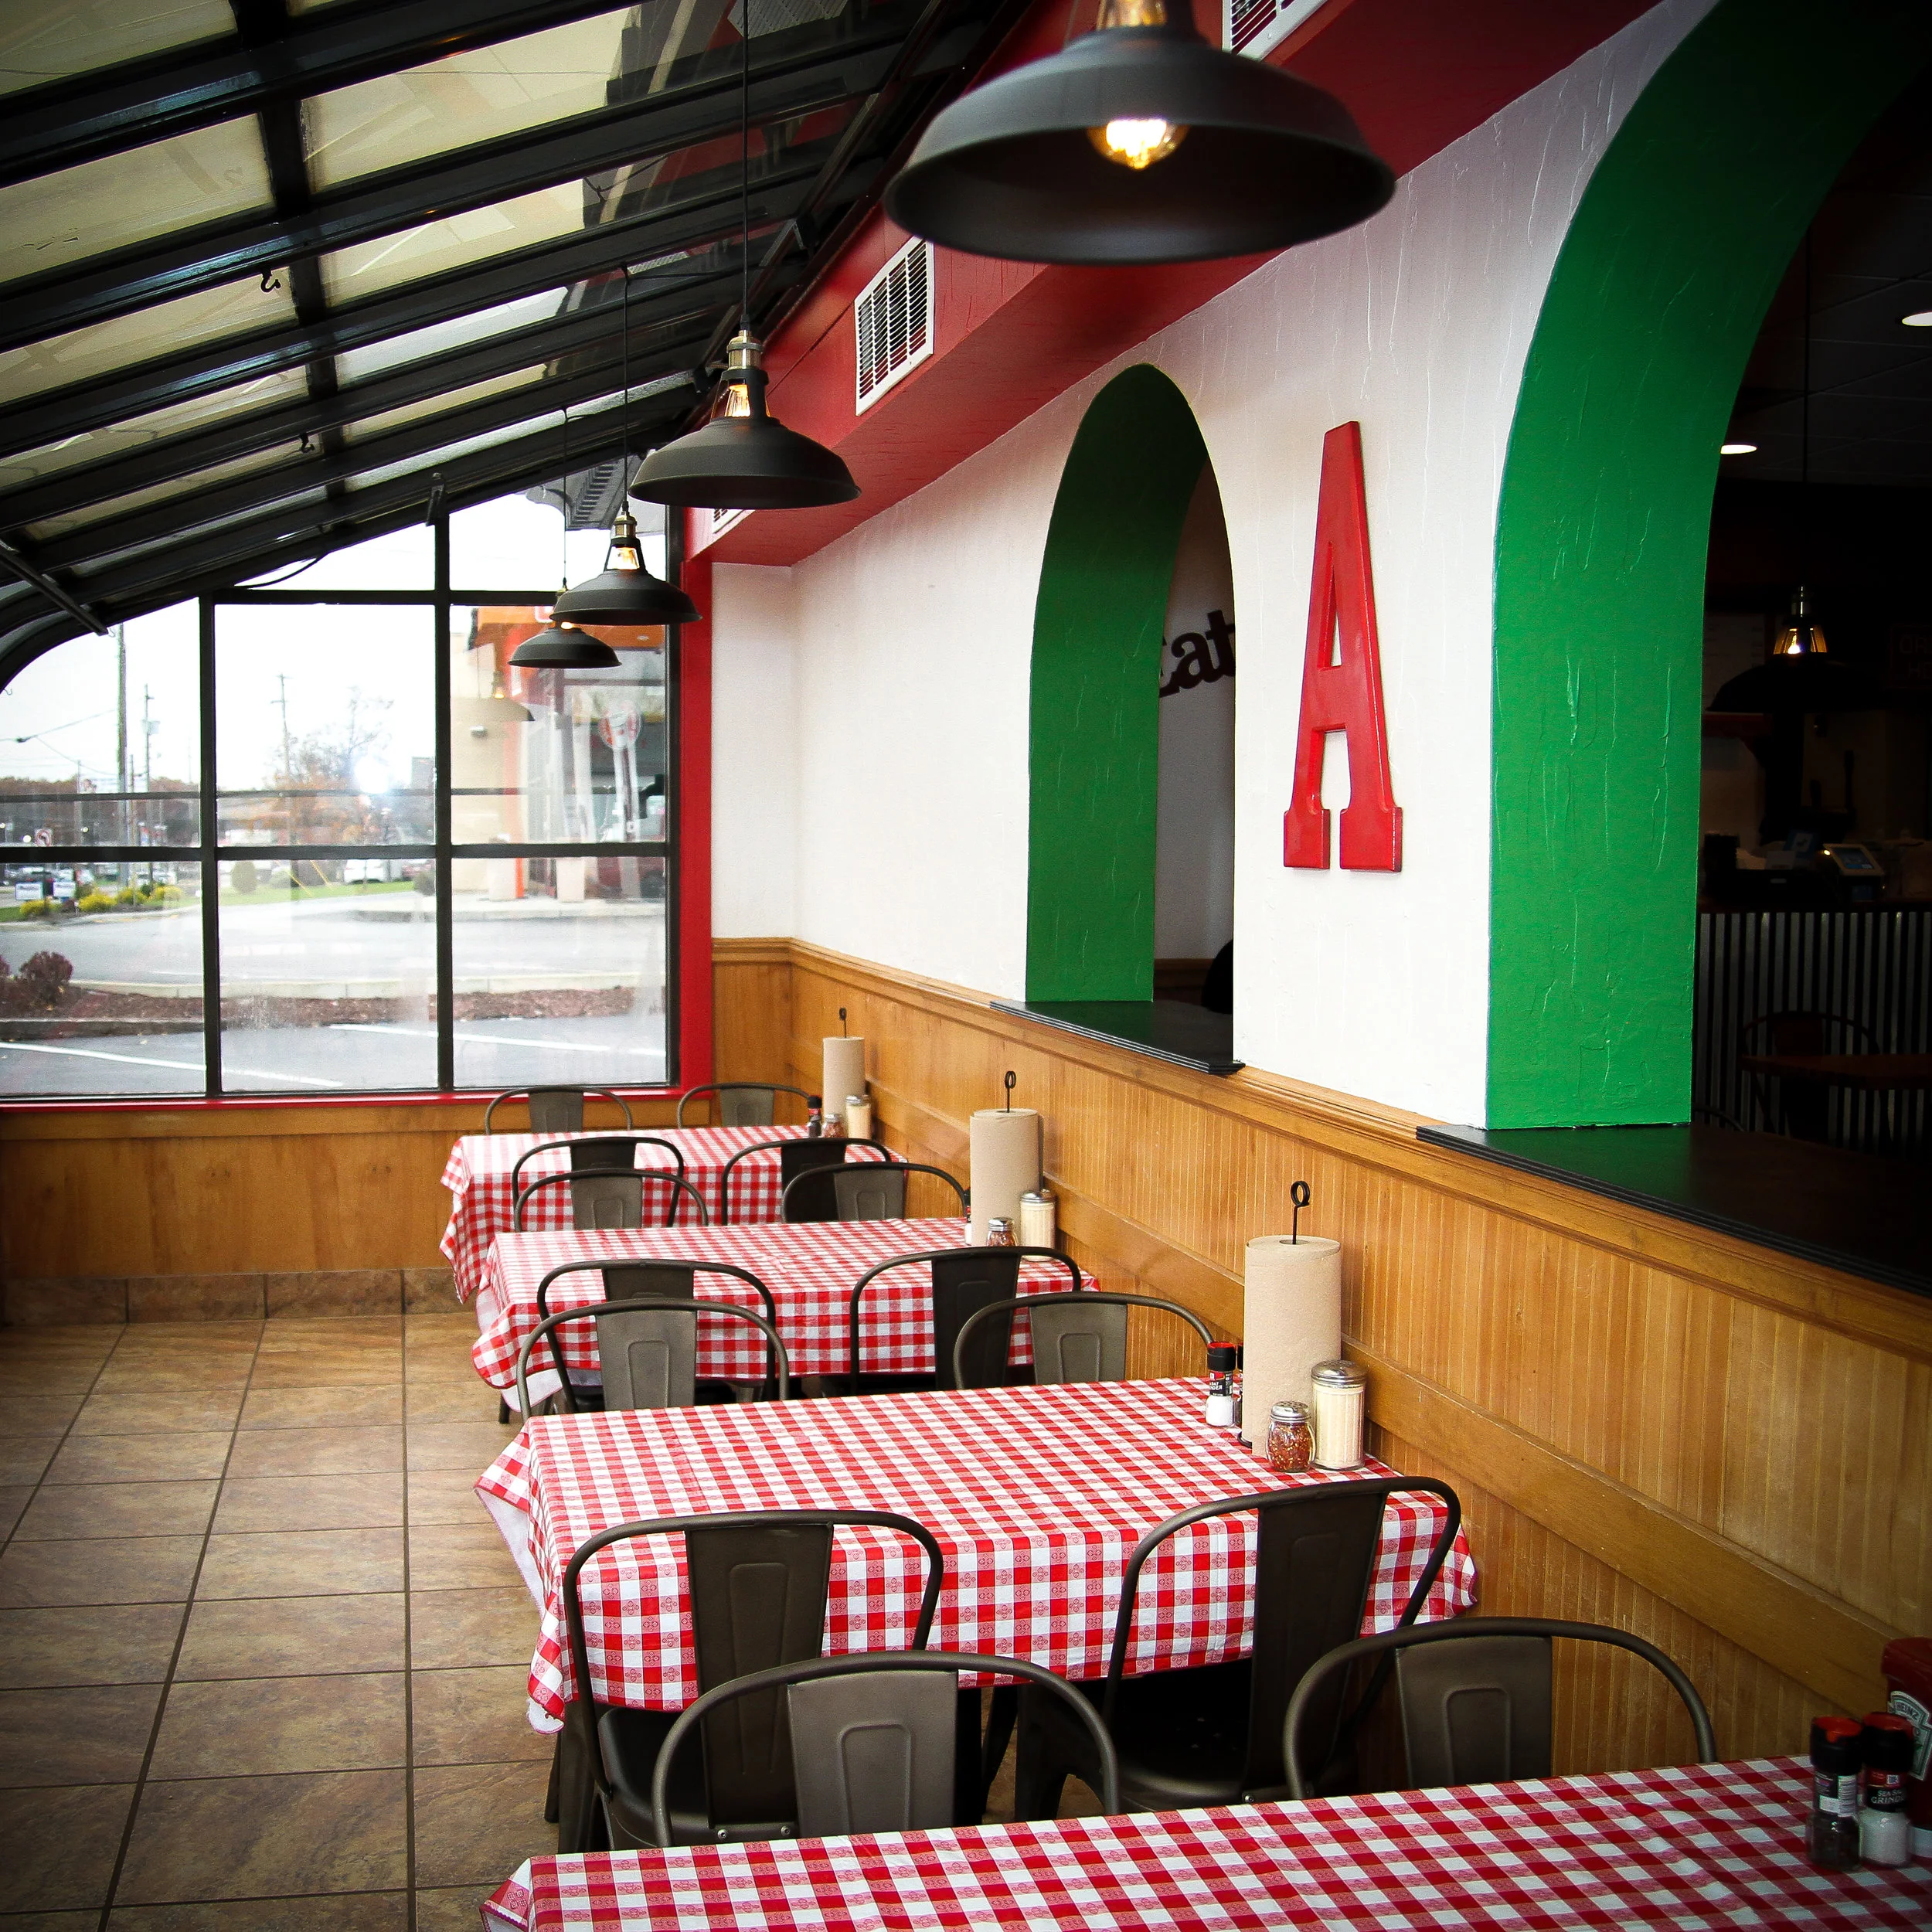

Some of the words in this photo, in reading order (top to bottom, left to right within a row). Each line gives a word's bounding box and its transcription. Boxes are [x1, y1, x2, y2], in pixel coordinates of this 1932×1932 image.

[1284, 420, 1403, 872] A
[1899, 634, 1932, 654] OR
[1894, 1701, 1919, 1721] HEINZ
[1870, 1795, 1904, 1804] GRIND
